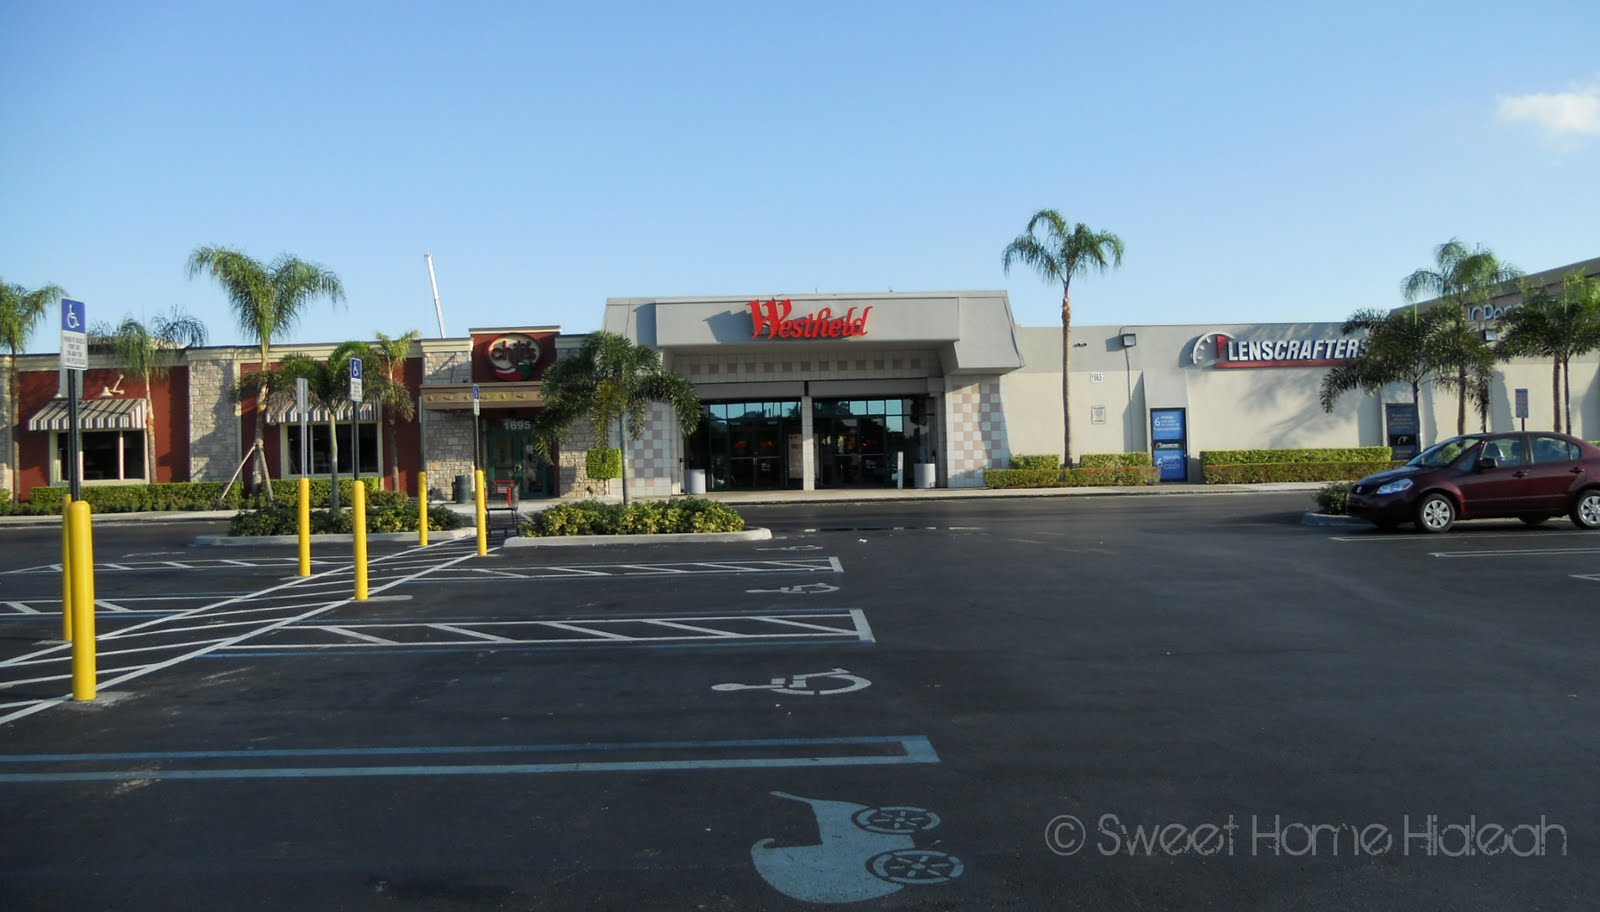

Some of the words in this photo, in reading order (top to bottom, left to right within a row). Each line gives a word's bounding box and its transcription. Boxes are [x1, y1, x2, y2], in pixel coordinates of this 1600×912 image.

[745, 297, 873, 339] Westfield
[504, 421, 531, 430] 1695
[1154, 417, 1161, 427] 6
[1157, 457, 1163, 468] 6
[1163, 462, 1180, 470] cash
